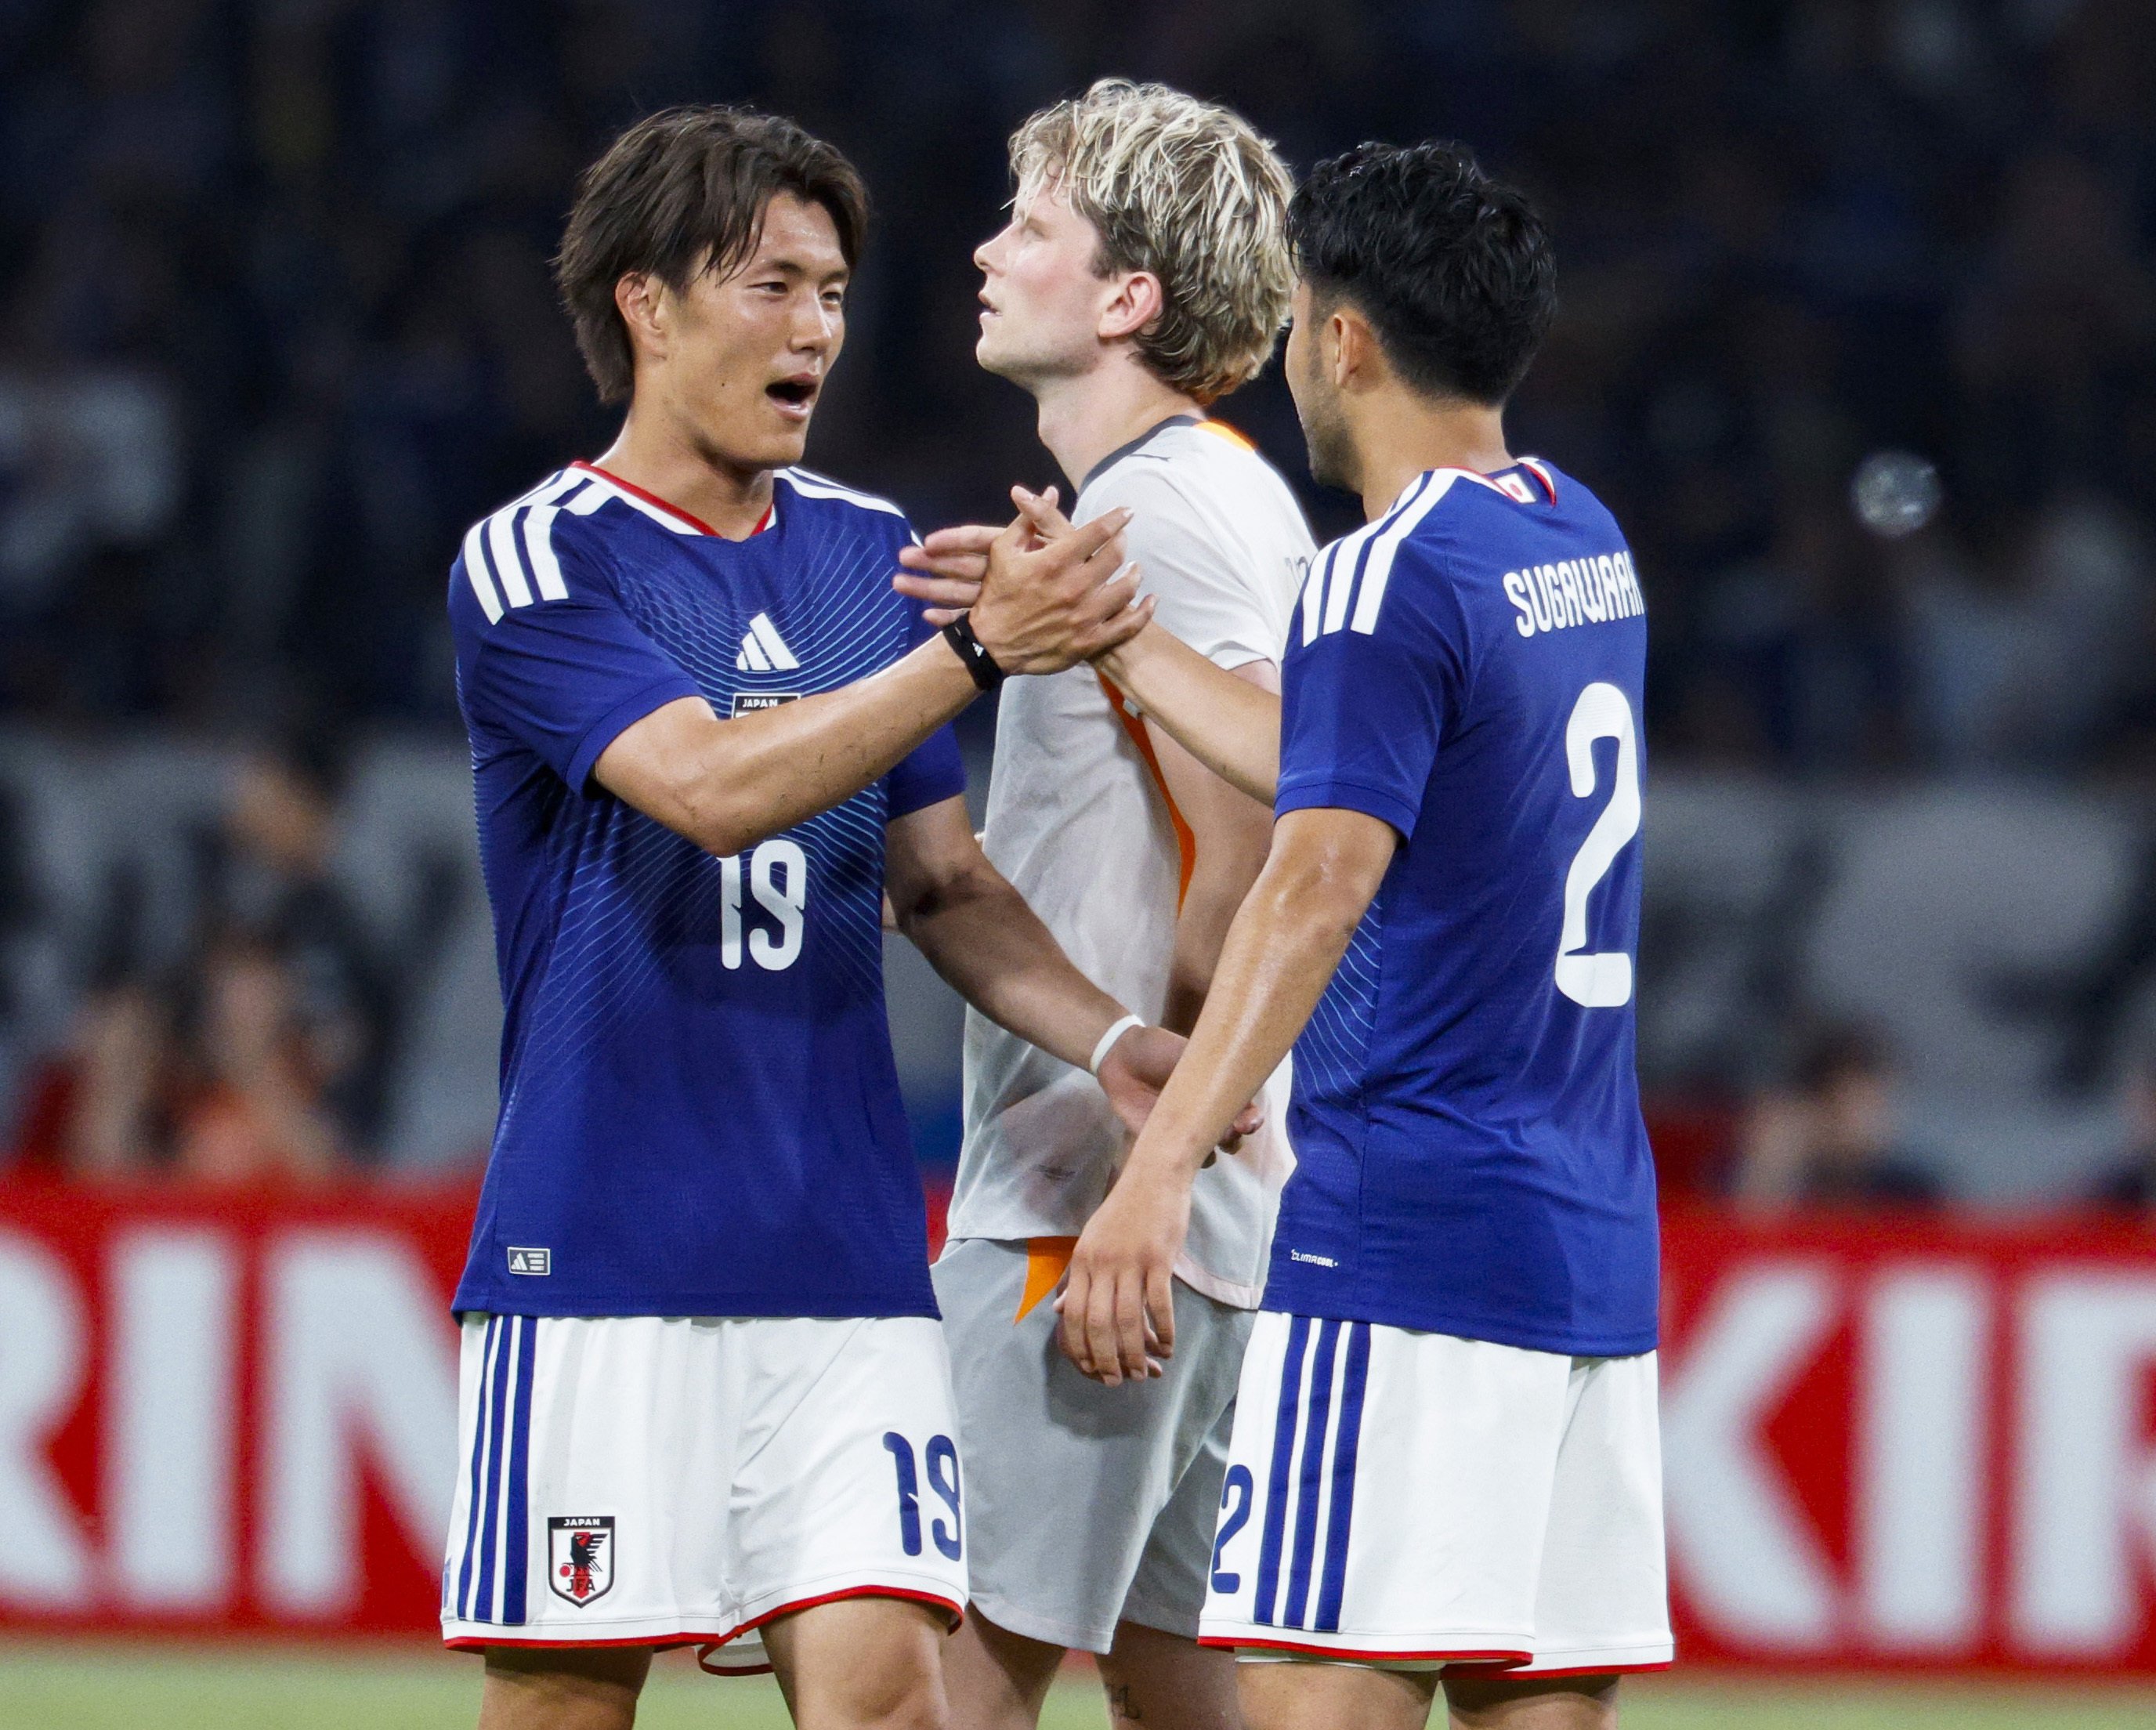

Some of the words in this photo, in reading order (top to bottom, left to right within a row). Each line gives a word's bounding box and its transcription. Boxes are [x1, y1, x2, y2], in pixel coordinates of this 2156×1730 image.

[742, 698, 778, 708] JAPAN
[716, 839, 807, 971] 19
[1555, 682, 1641, 1008] 2
[882, 1431, 962, 1562] 19
[1211, 1464, 1253, 1594] 2
